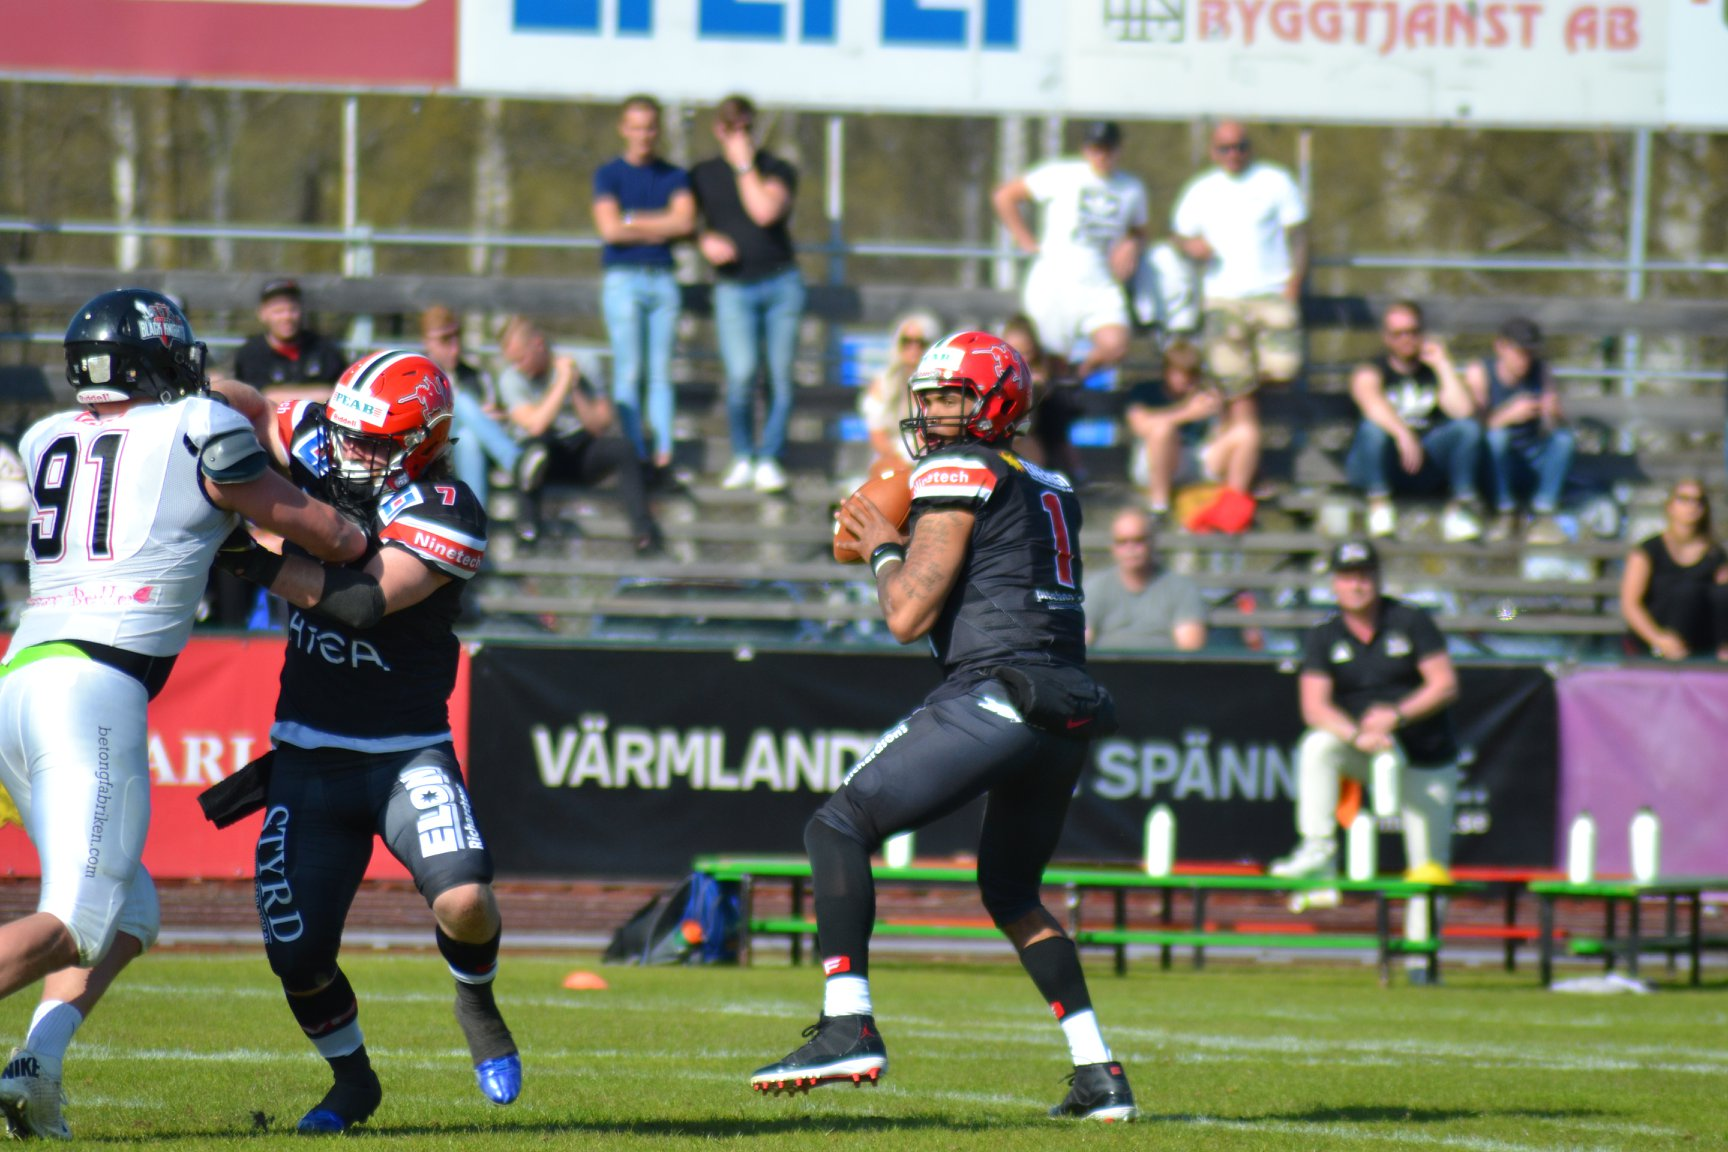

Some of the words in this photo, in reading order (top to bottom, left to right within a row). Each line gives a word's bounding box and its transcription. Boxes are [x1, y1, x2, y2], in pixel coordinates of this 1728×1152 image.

[1563, 4, 1639, 53] AB
[332, 412, 357, 427] Riddell
[335, 391, 376, 416] PEAB
[31, 428, 130, 565] 91
[434, 486, 456, 506] 7
[413, 531, 481, 569] Ninetech
[1040, 490, 1075, 589] 1
[84, 725, 114, 879] betongfabriken.com
[398, 766, 463, 858] ELON
[258, 806, 304, 943] STYRD
[1, 1056, 40, 1079] NIKE
